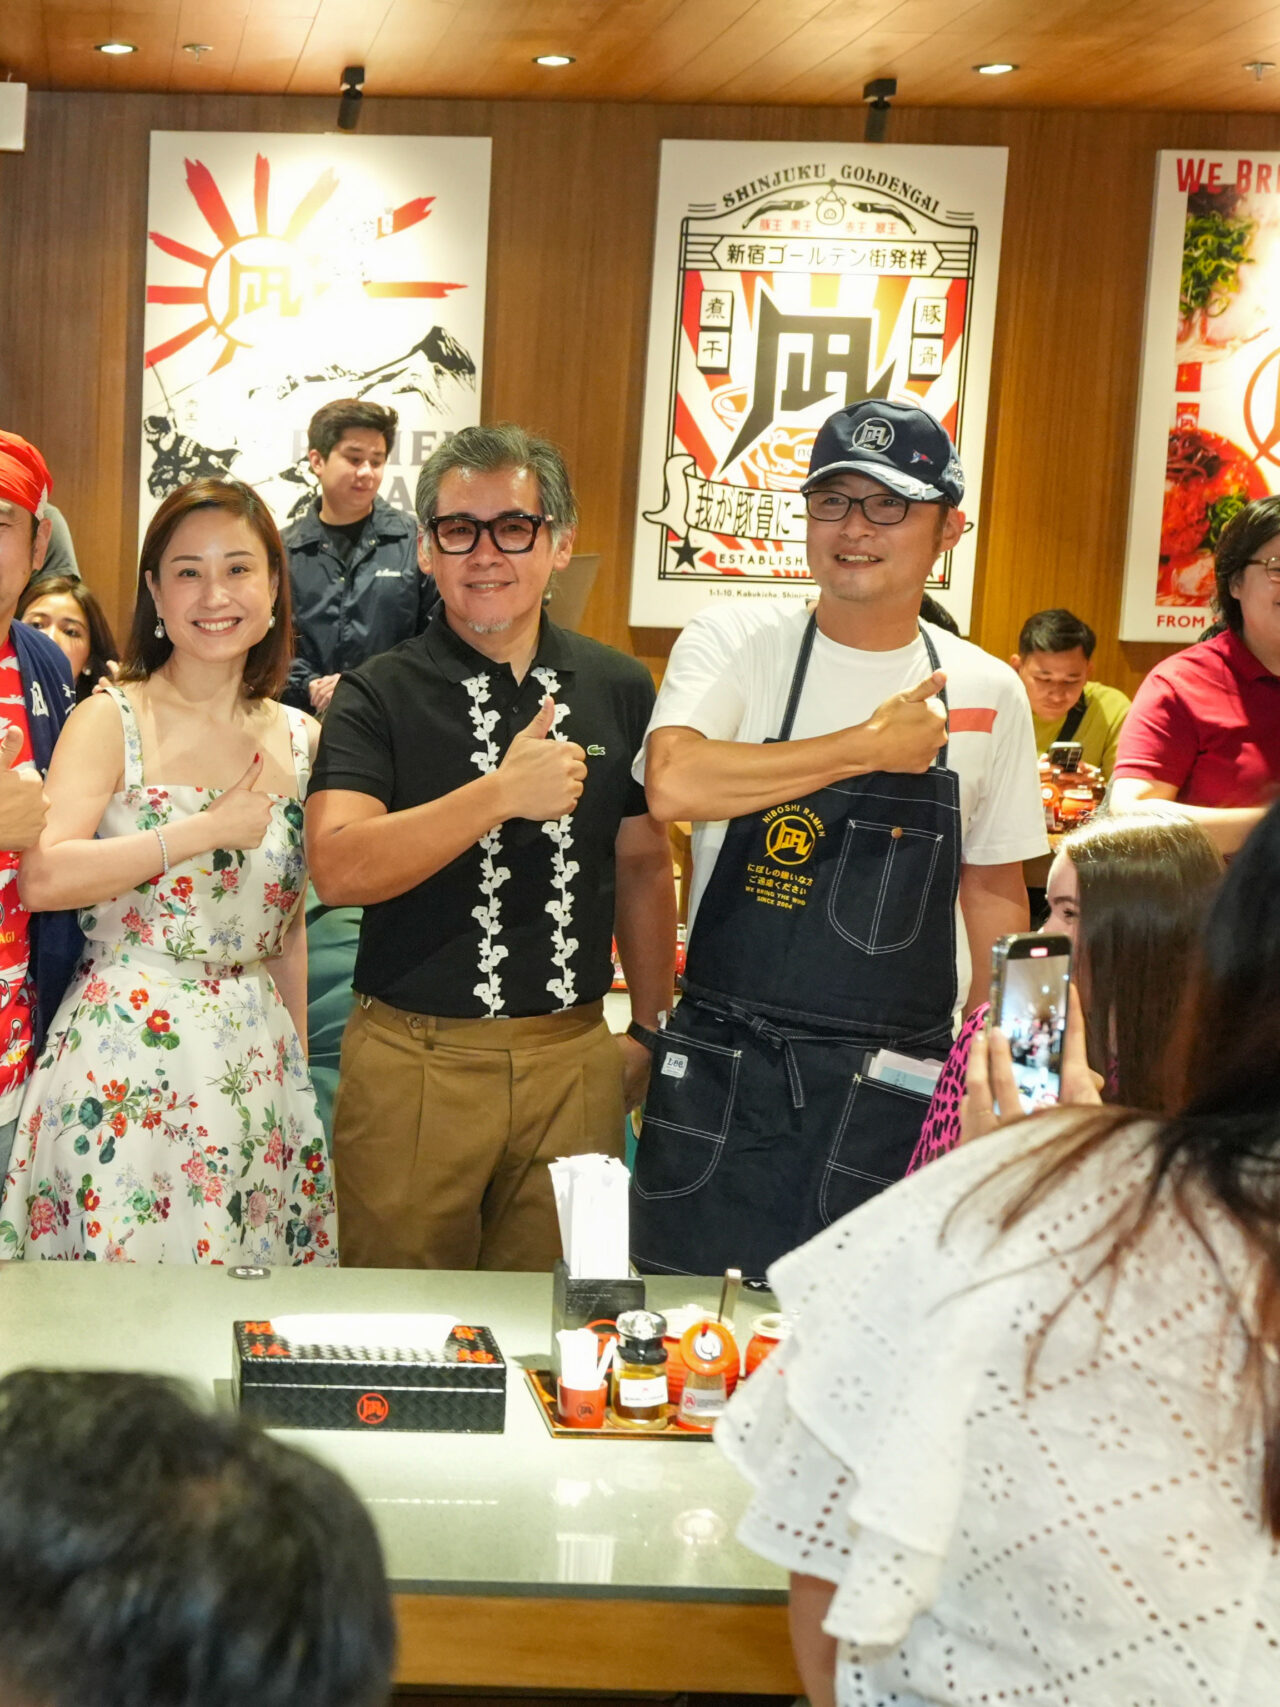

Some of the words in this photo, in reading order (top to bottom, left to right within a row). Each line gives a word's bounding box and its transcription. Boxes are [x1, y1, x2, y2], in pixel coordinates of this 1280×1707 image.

[722, 163, 826, 208] SHINJUKU
[840, 164, 940, 214] GOLDENGAI
[1176, 158, 1223, 194] WE
[1236, 159, 1280, 194] BRI
[719, 553, 803, 566] ESTABLISH
[1156, 614, 1206, 628] FROM
[762, 804, 800, 824] NIBOSHI
[803, 807, 826, 837] RAMEN
